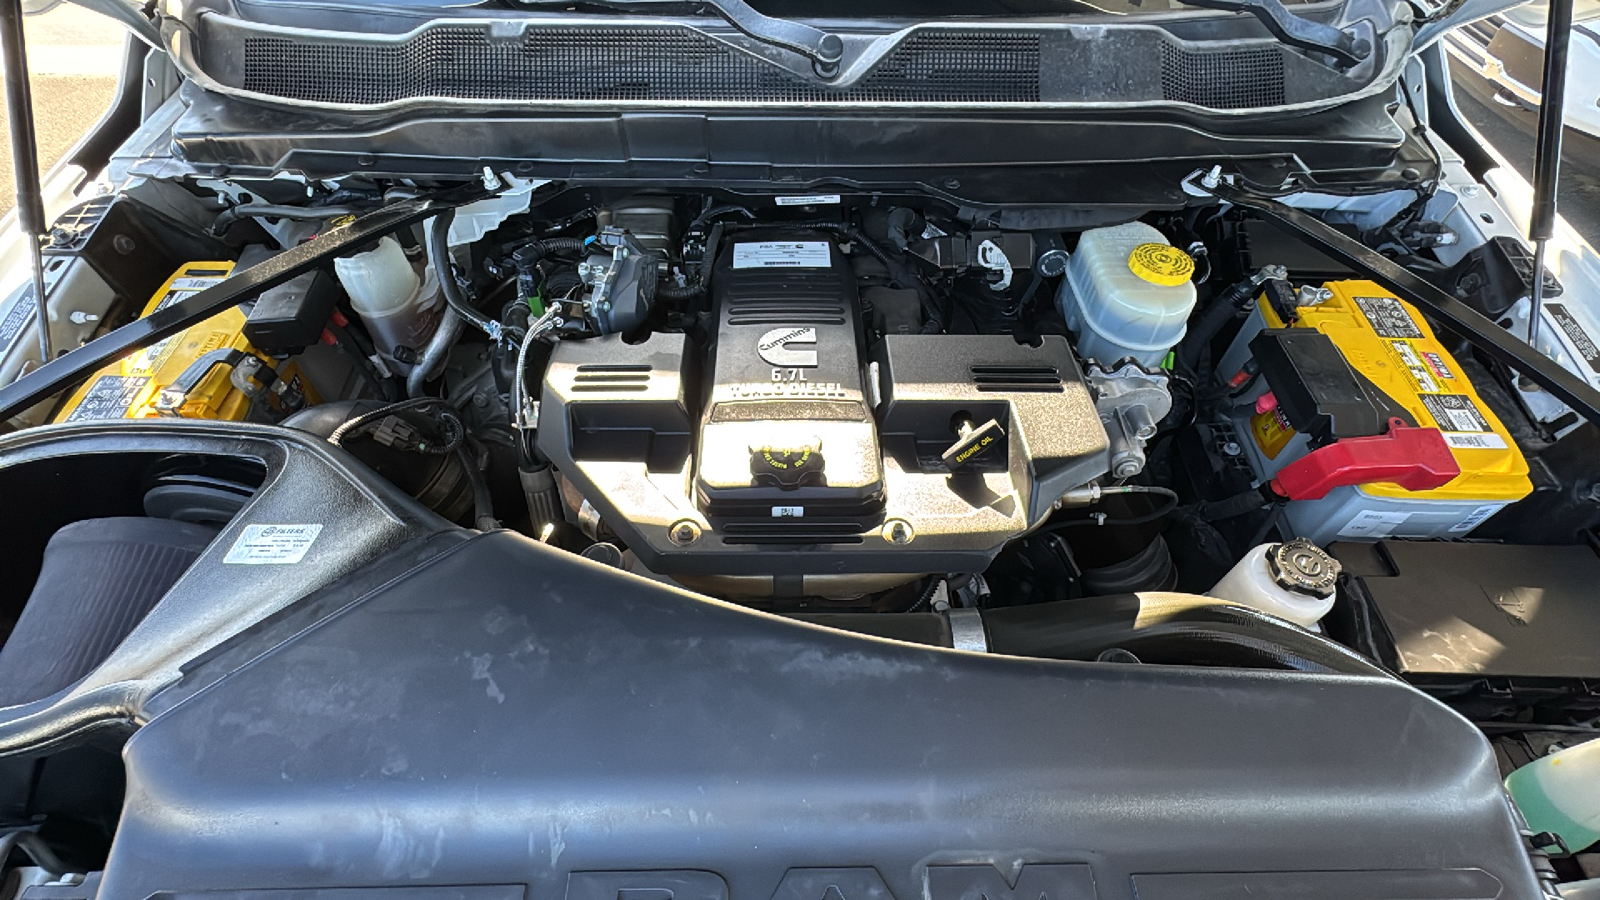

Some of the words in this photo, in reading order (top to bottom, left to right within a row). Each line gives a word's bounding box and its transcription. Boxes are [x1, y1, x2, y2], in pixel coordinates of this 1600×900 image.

[758, 327, 811, 351] Cummins
[771, 367, 808, 382] 6.7L
[788, 382, 846, 398] DIESEL
[955, 442, 981, 463] ENGINE
[980, 435, 994, 446] OIL
